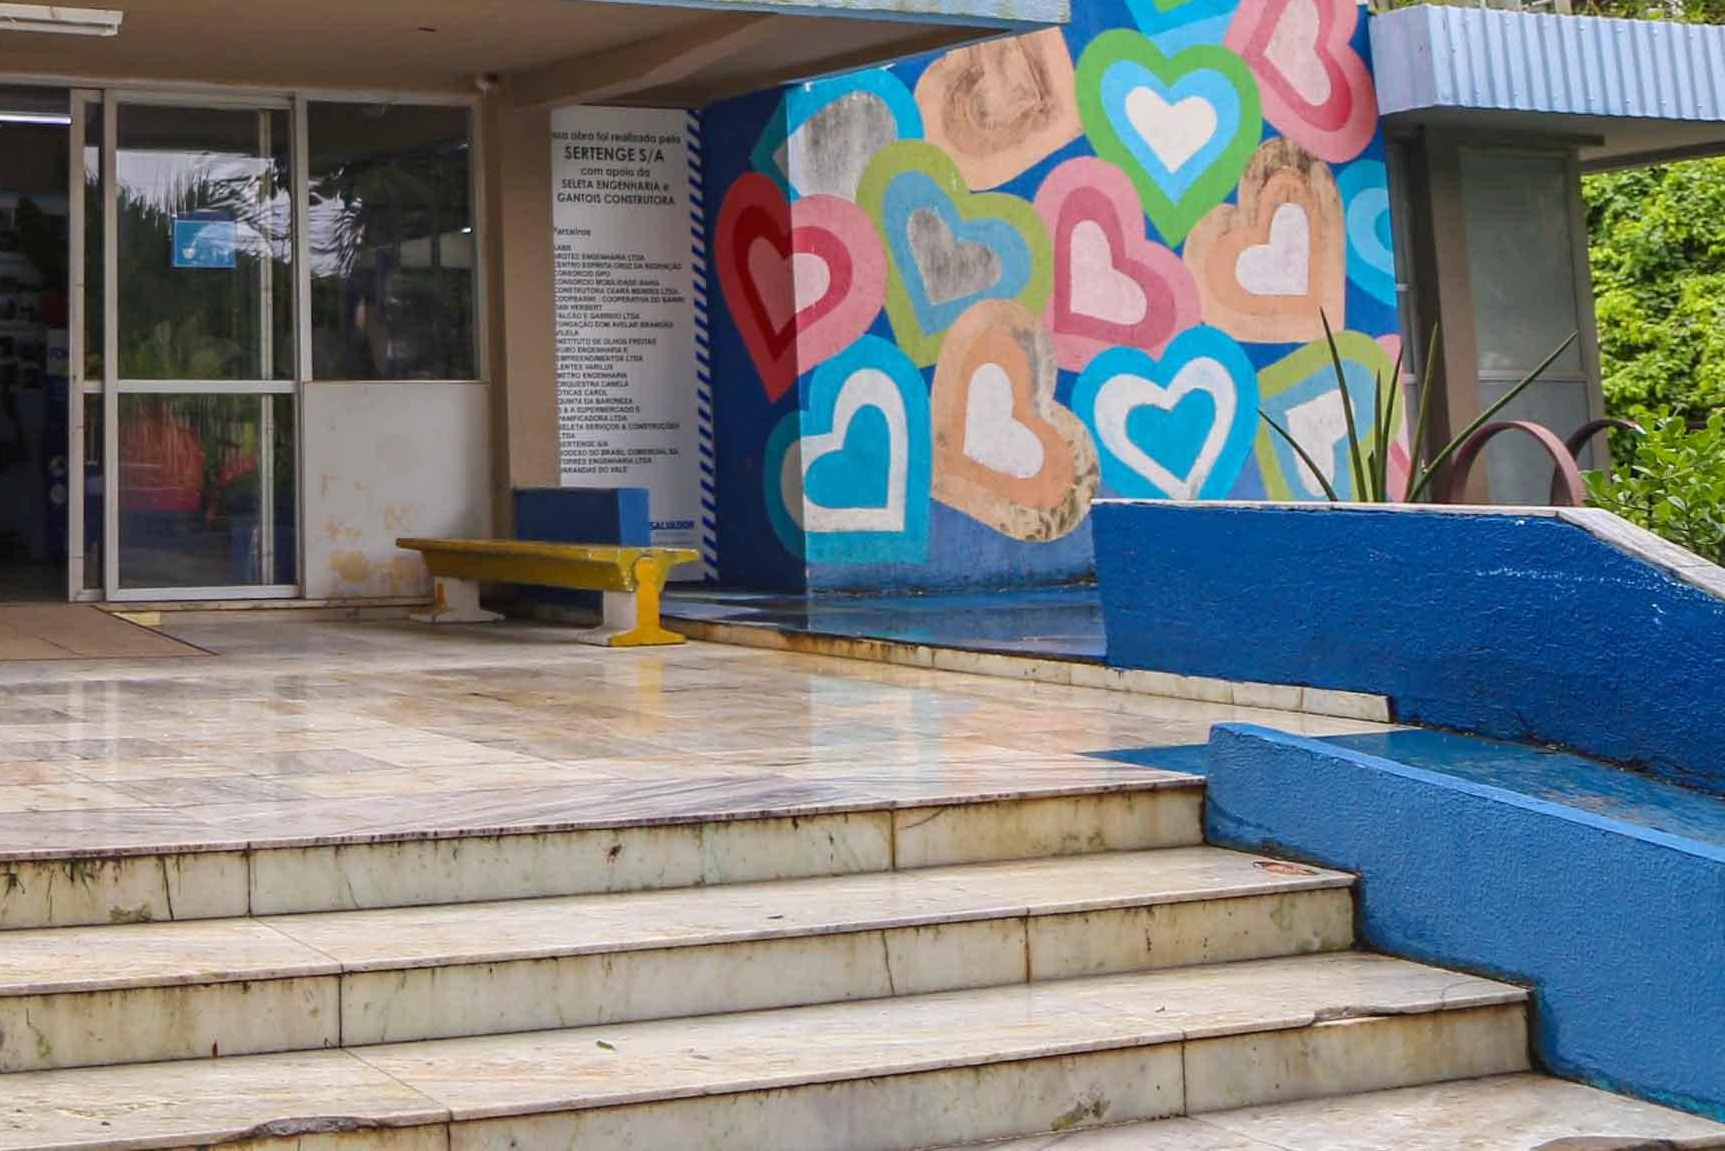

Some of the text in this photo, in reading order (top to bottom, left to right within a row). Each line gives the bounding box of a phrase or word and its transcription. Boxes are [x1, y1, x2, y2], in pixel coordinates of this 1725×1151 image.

[570, 130, 594, 141] obra
[596, 130, 609, 142] foi
[564, 145, 665, 165] SERTENGE S/A
[580, 167, 603, 176] com
[605, 167, 635, 179] apoio
[561, 178, 594, 190] SELETA
[596, 179, 660, 192] ENGENHARIA
[556, 192, 676, 206] GANTOIS CONSTRUTORA
